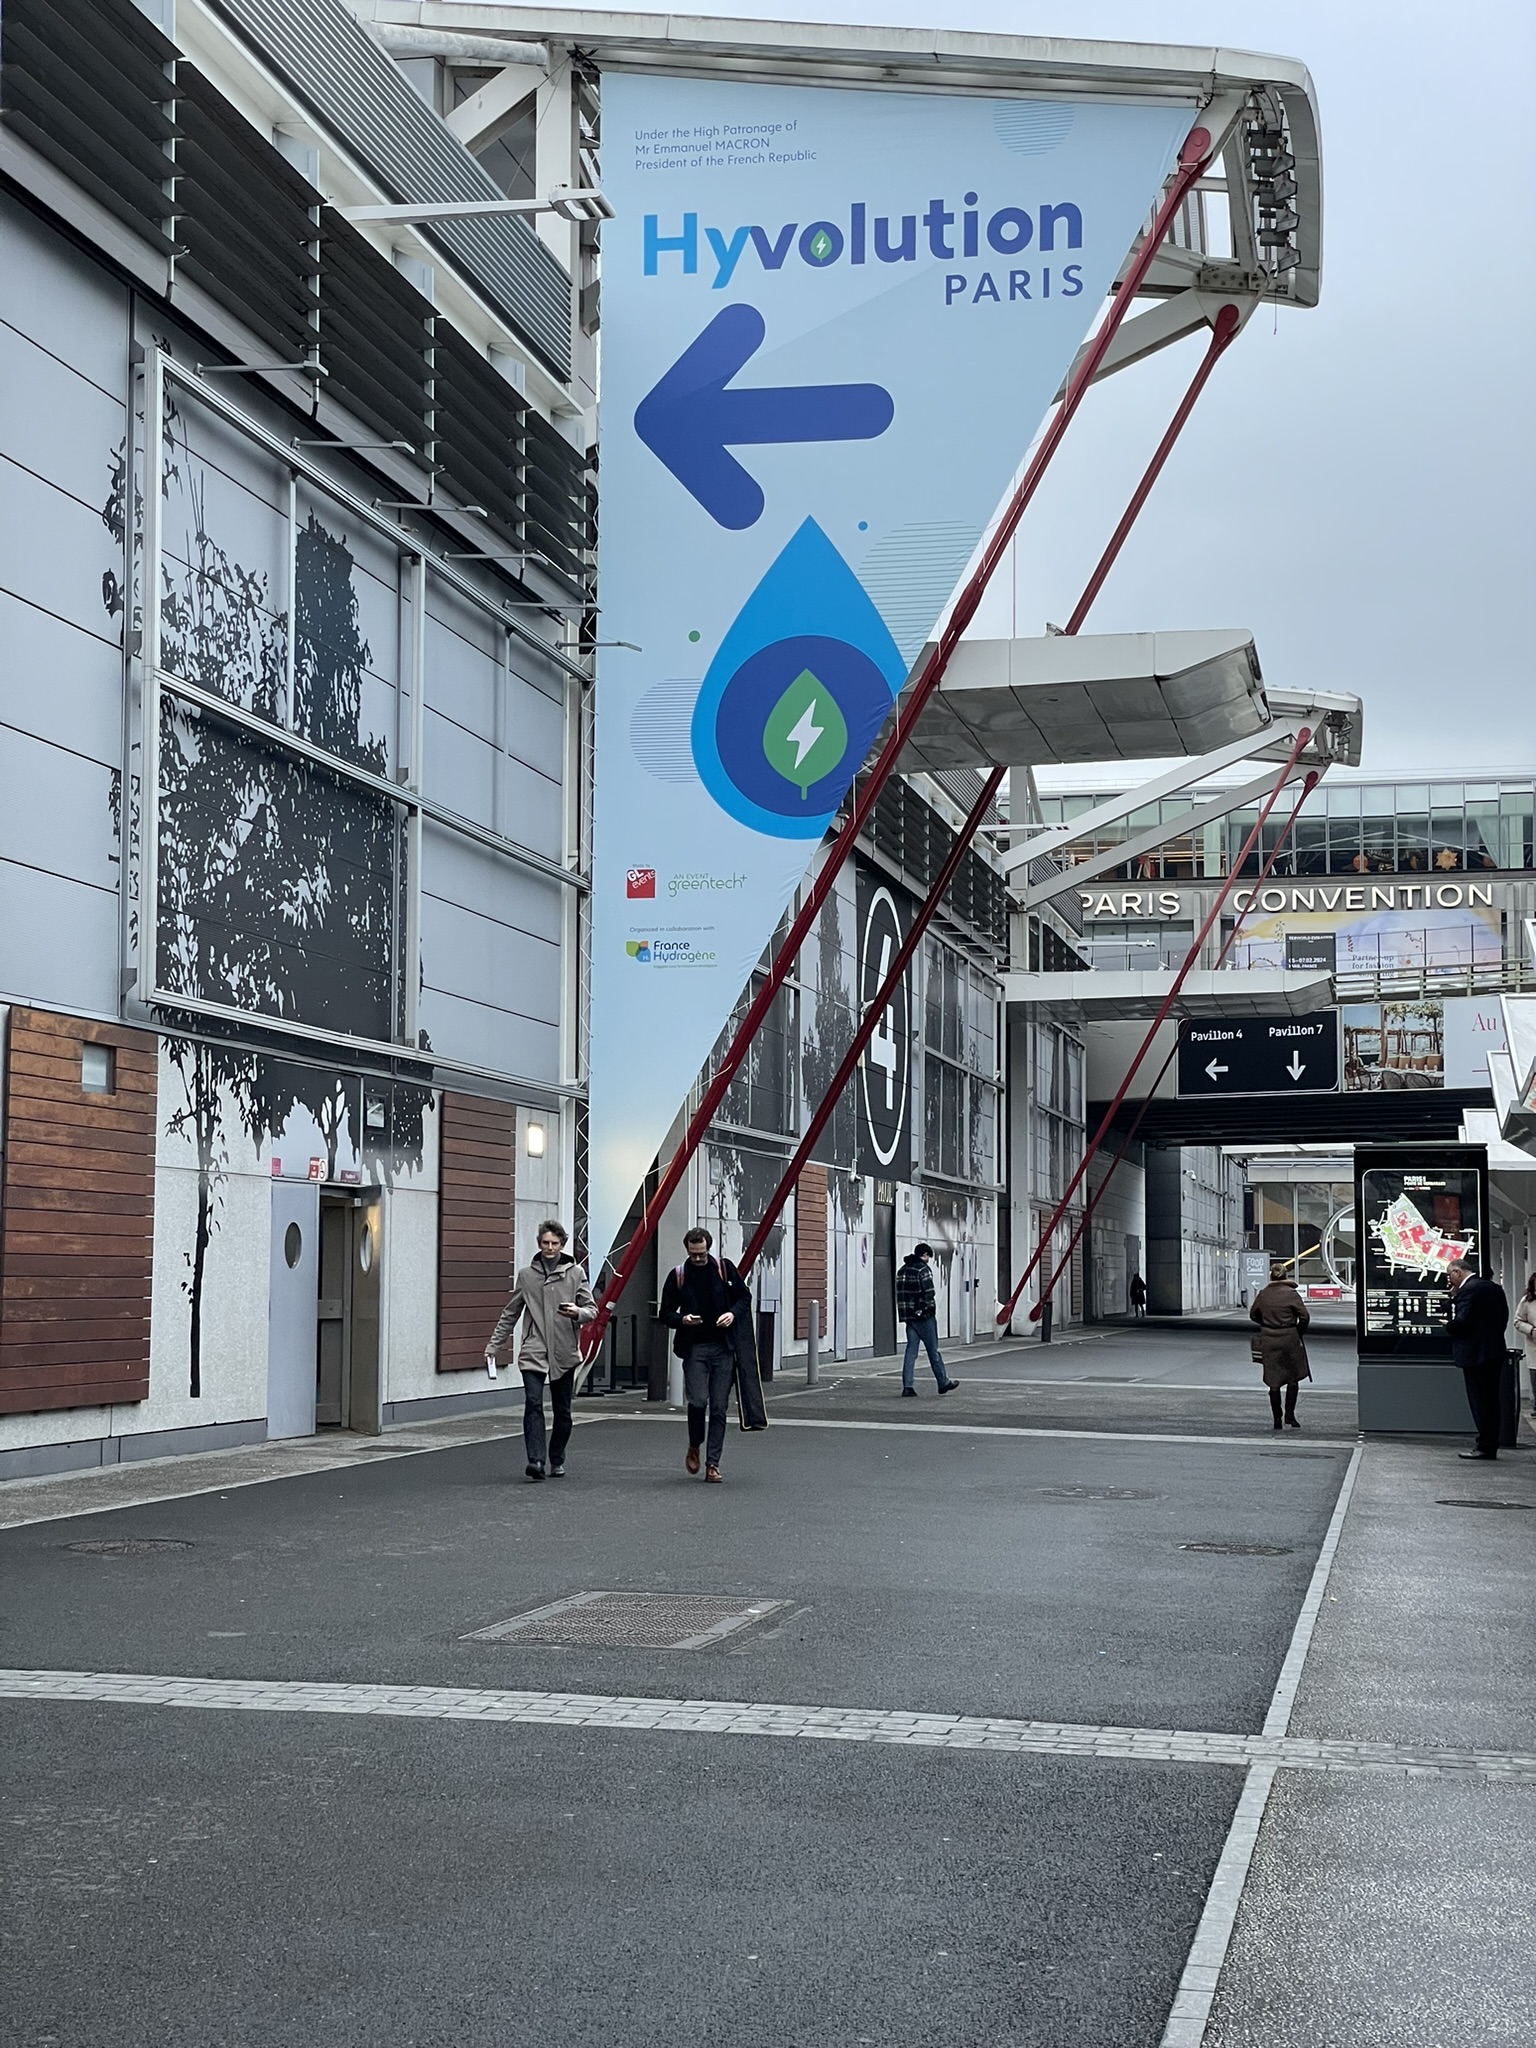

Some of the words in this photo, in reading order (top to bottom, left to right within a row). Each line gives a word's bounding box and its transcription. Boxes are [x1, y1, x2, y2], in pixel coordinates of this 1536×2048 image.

[635, 130, 669, 140] Under
[672, 127, 690, 138] the
[693, 126, 720, 139] High
[723, 122, 782, 136] Patronage
[785, 120, 798, 132] of
[635, 145, 650, 155] Mr
[653, 141, 712, 154] Emmanuel
[715, 138, 770, 150] MACRON
[635, 158, 687, 170] President
[690, 156, 703, 167] of
[706, 156, 724, 166] the
[727, 153, 765, 165] French
[768, 150, 817, 163] Republic
[643, 191, 1083, 290] Hyvolution
[945, 264, 1084, 306] PARIS
[627, 869, 645, 882] GL
[631, 870, 656, 889] events
[686, 872, 709, 880] EVENT
[1080, 892, 1180, 915] PARIS
[1233, 883, 1493, 914] CONVENTION
[629, 926, 659, 934] Organized
[653, 940, 690, 951] France
[653, 950, 716, 963] Hydrogène
[1352, 954, 1395, 963] Partne-up
[1352, 962, 1364, 970] for
[1471, 1012, 1498, 1032] Au
[1191, 1030, 1234, 1042] Pavillon
[1236, 1029, 1243, 1039] 4
[1269, 1025, 1315, 1037] Pavillon
[1316, 1024, 1324, 1035] 7
[1246, 1257, 1264, 1268] FOOD
